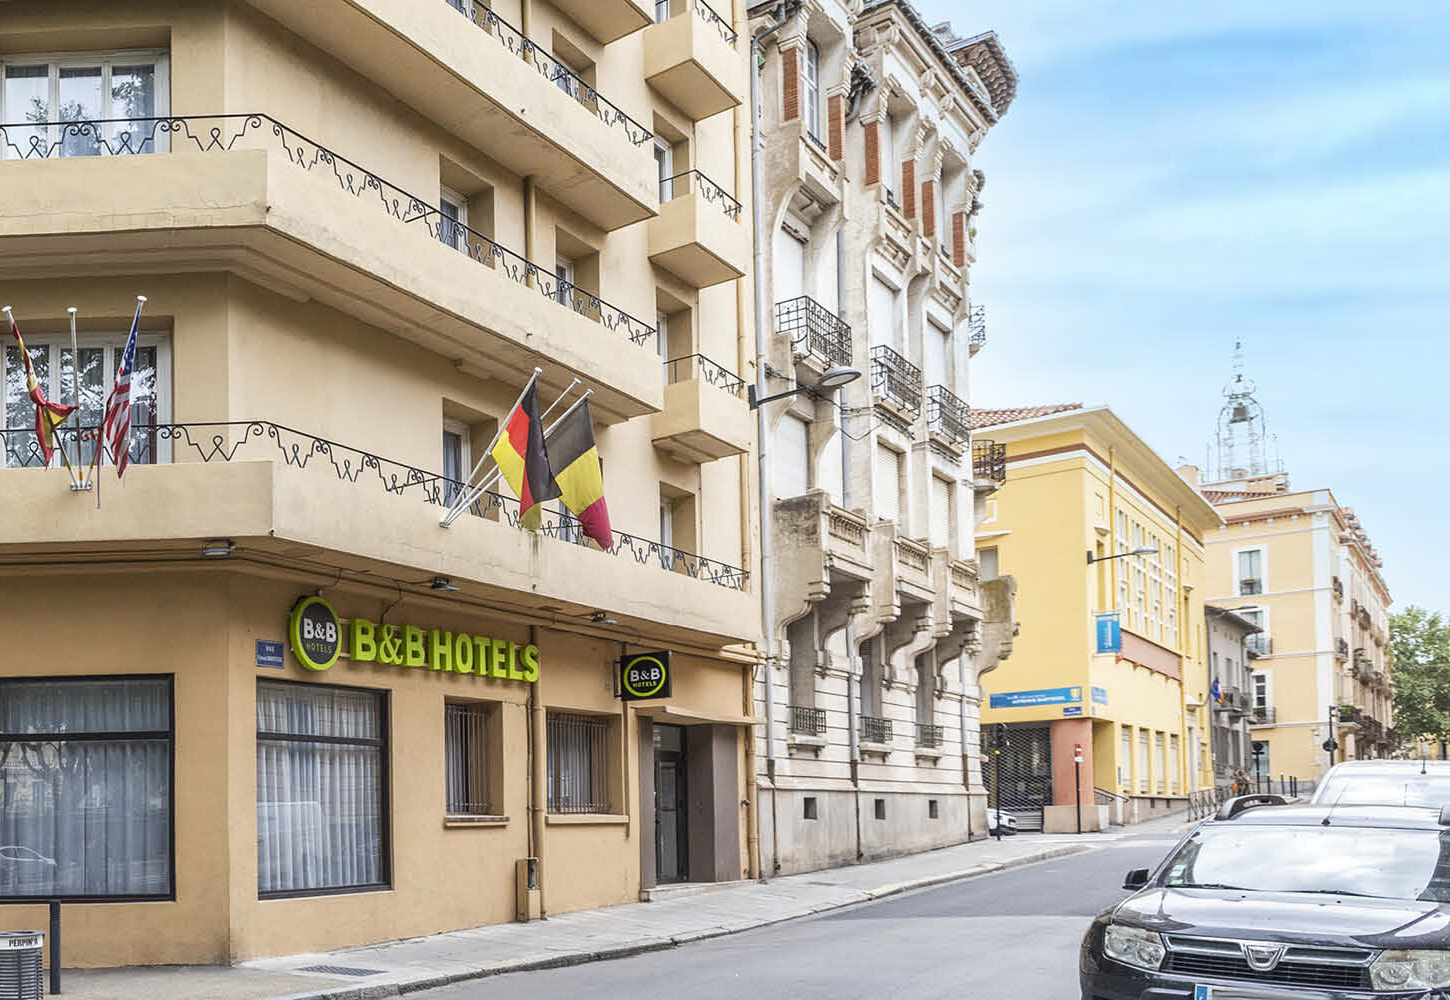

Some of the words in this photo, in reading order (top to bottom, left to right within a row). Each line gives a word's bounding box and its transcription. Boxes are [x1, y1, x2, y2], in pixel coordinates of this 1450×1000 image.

[303, 618, 337, 643] B&B
[306, 642, 333, 654] HOTELS
[350, 617, 425, 667] B&B
[428, 629, 539, 682] HOTELS
[630, 667, 661, 682] B&B
